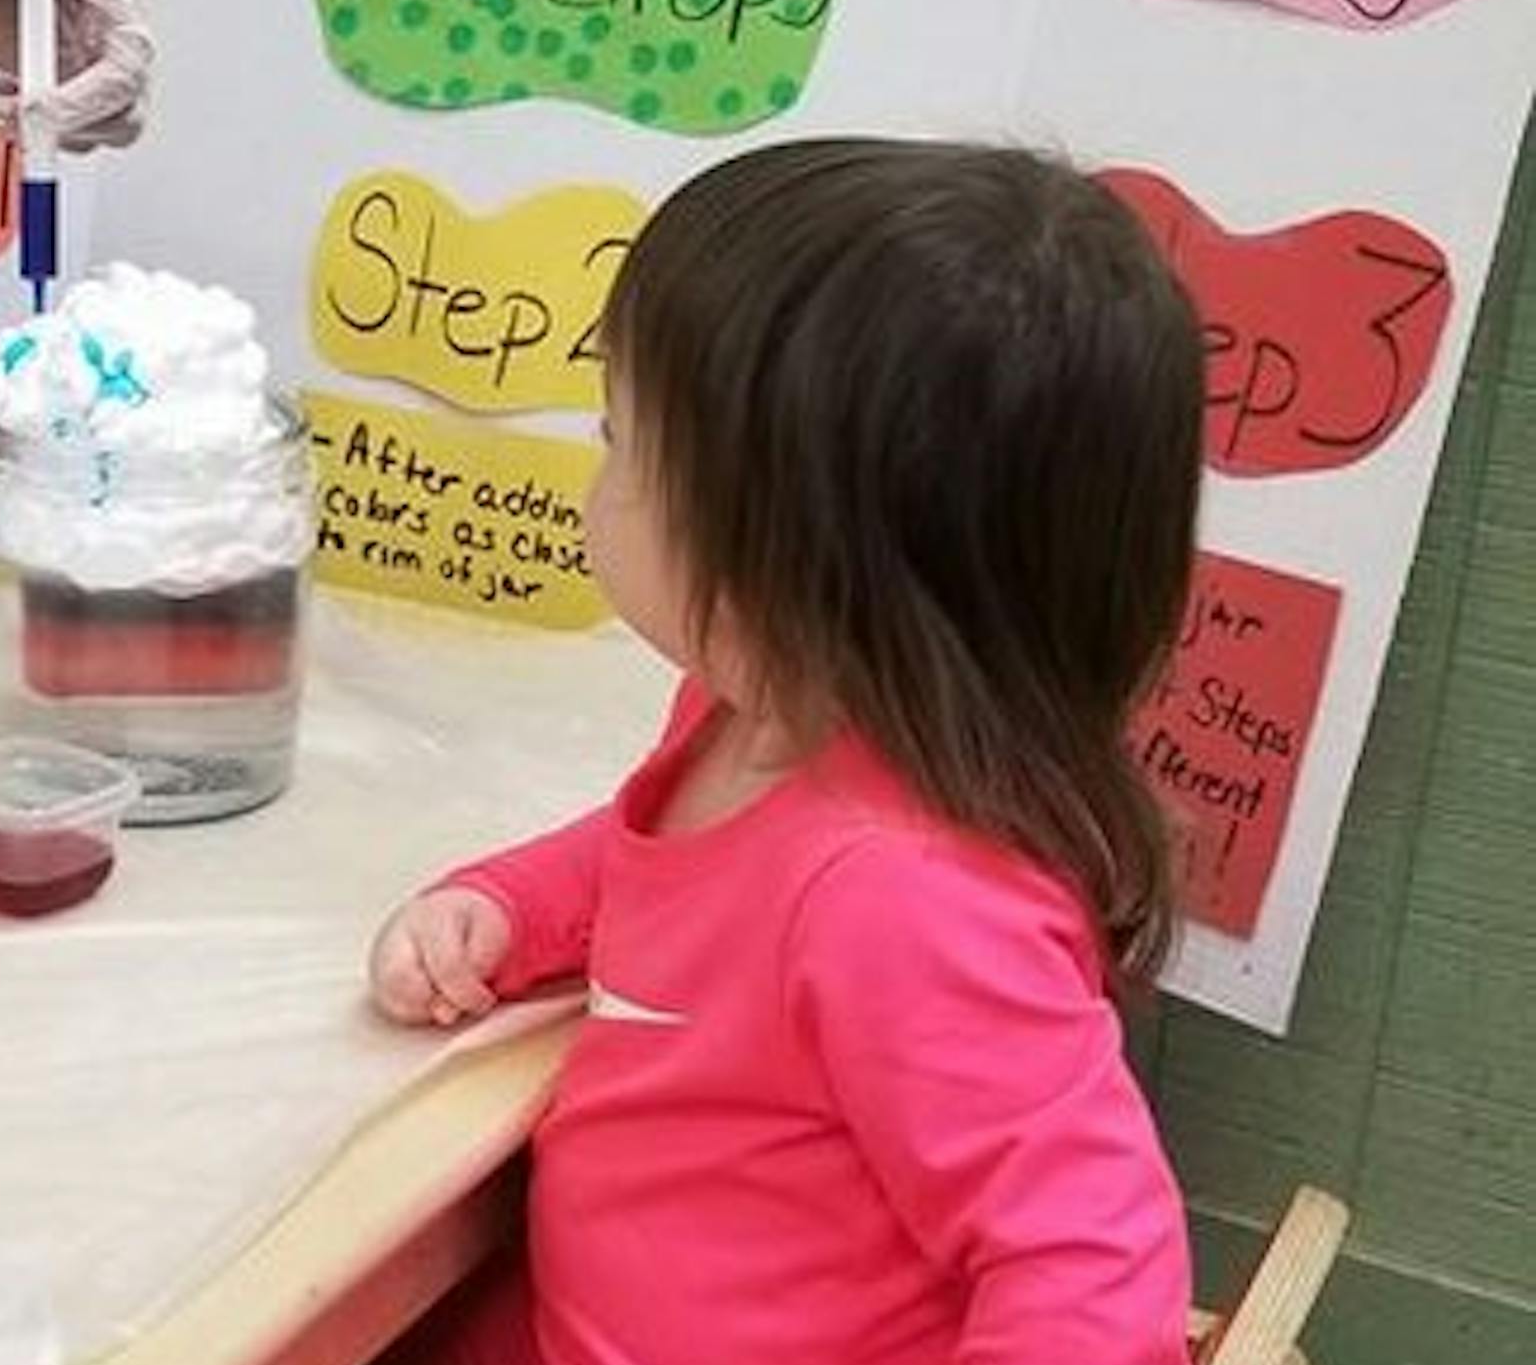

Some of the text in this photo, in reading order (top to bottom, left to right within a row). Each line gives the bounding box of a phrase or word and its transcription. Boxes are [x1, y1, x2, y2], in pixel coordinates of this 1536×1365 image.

[328, 191, 636, 388] Step 2
[1196, 244, 1449, 460] ep 3
[453, 521, 495, 552] as
[472, 478, 583, 530] addin
[362, 537, 423, 571] rim
[440, 555, 473, 583] of
[478, 567, 546, 602] jar
[1186, 676, 1294, 758] Steps
